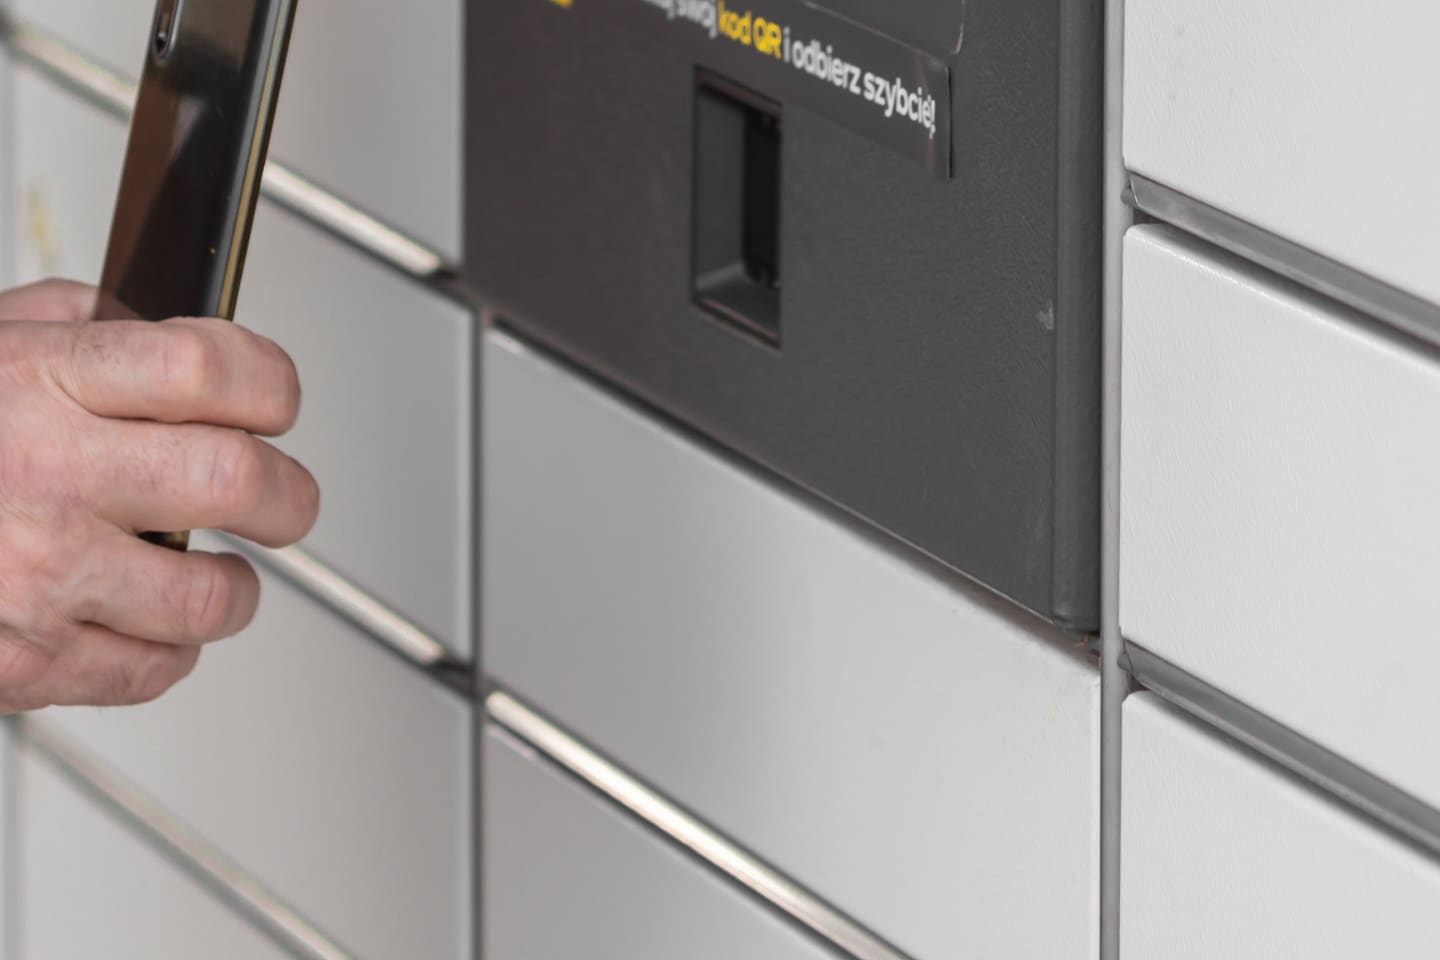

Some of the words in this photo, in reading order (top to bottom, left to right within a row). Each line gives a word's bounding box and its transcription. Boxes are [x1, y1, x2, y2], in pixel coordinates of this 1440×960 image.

[718, 0, 751, 45] kod
[753, 16, 782, 60] QR
[783, 26, 791, 62] i
[792, 40, 861, 95] odbierz
[863, 72, 936, 140] szybciej!
